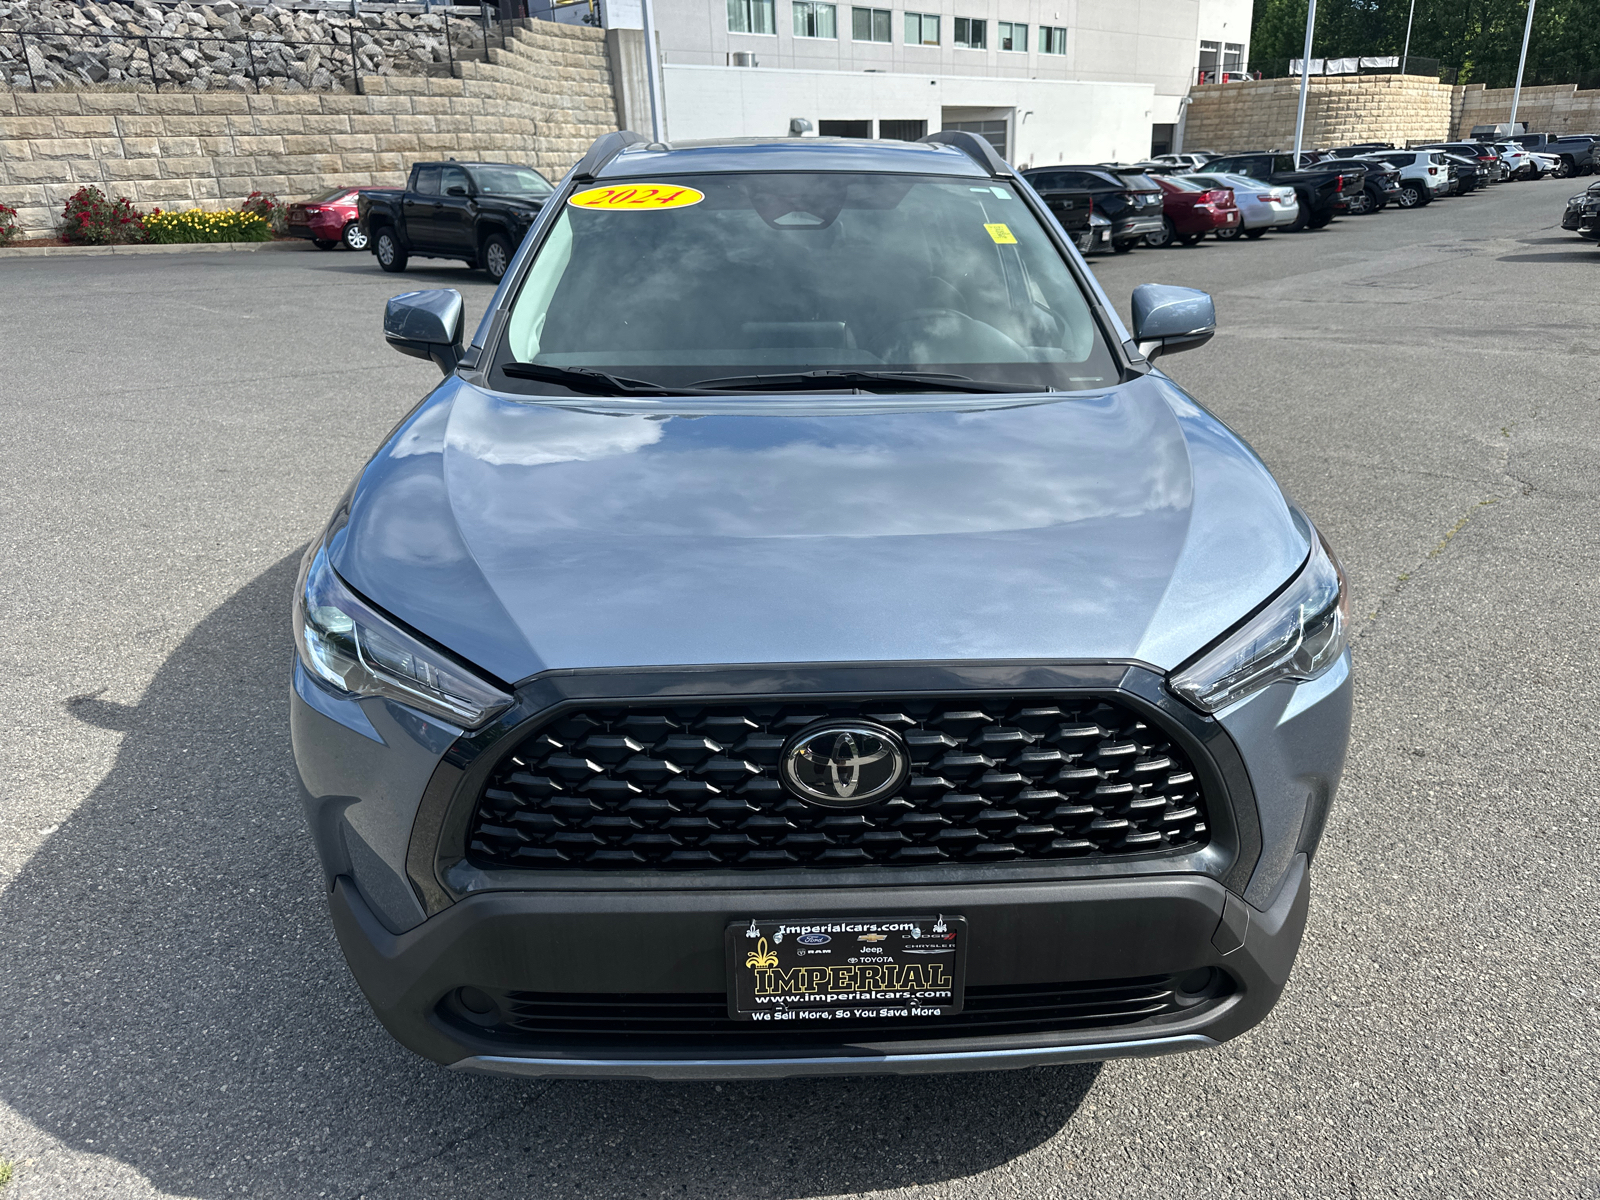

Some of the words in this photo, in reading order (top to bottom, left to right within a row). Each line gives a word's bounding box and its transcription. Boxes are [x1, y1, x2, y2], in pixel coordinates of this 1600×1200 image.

[584, 189, 687, 205] 2024
[779, 923, 914, 935] Imperialcars.com
[860, 946, 883, 954] Jeep
[860, 956, 894, 964] TOYOTA
[754, 963, 952, 995] IMPERIAL
[755, 991, 952, 1003] www.imperialcars.com
[751, 1012, 771, 1020] We
[774, 1011, 796, 1020] Sell
[799, 1010, 832, 1020] More,
[835, 1009, 851, 1018] So
[854, 1009, 877, 1018] You
[879, 1008, 908, 1017] Save
[911, 1007, 941, 1016] More
